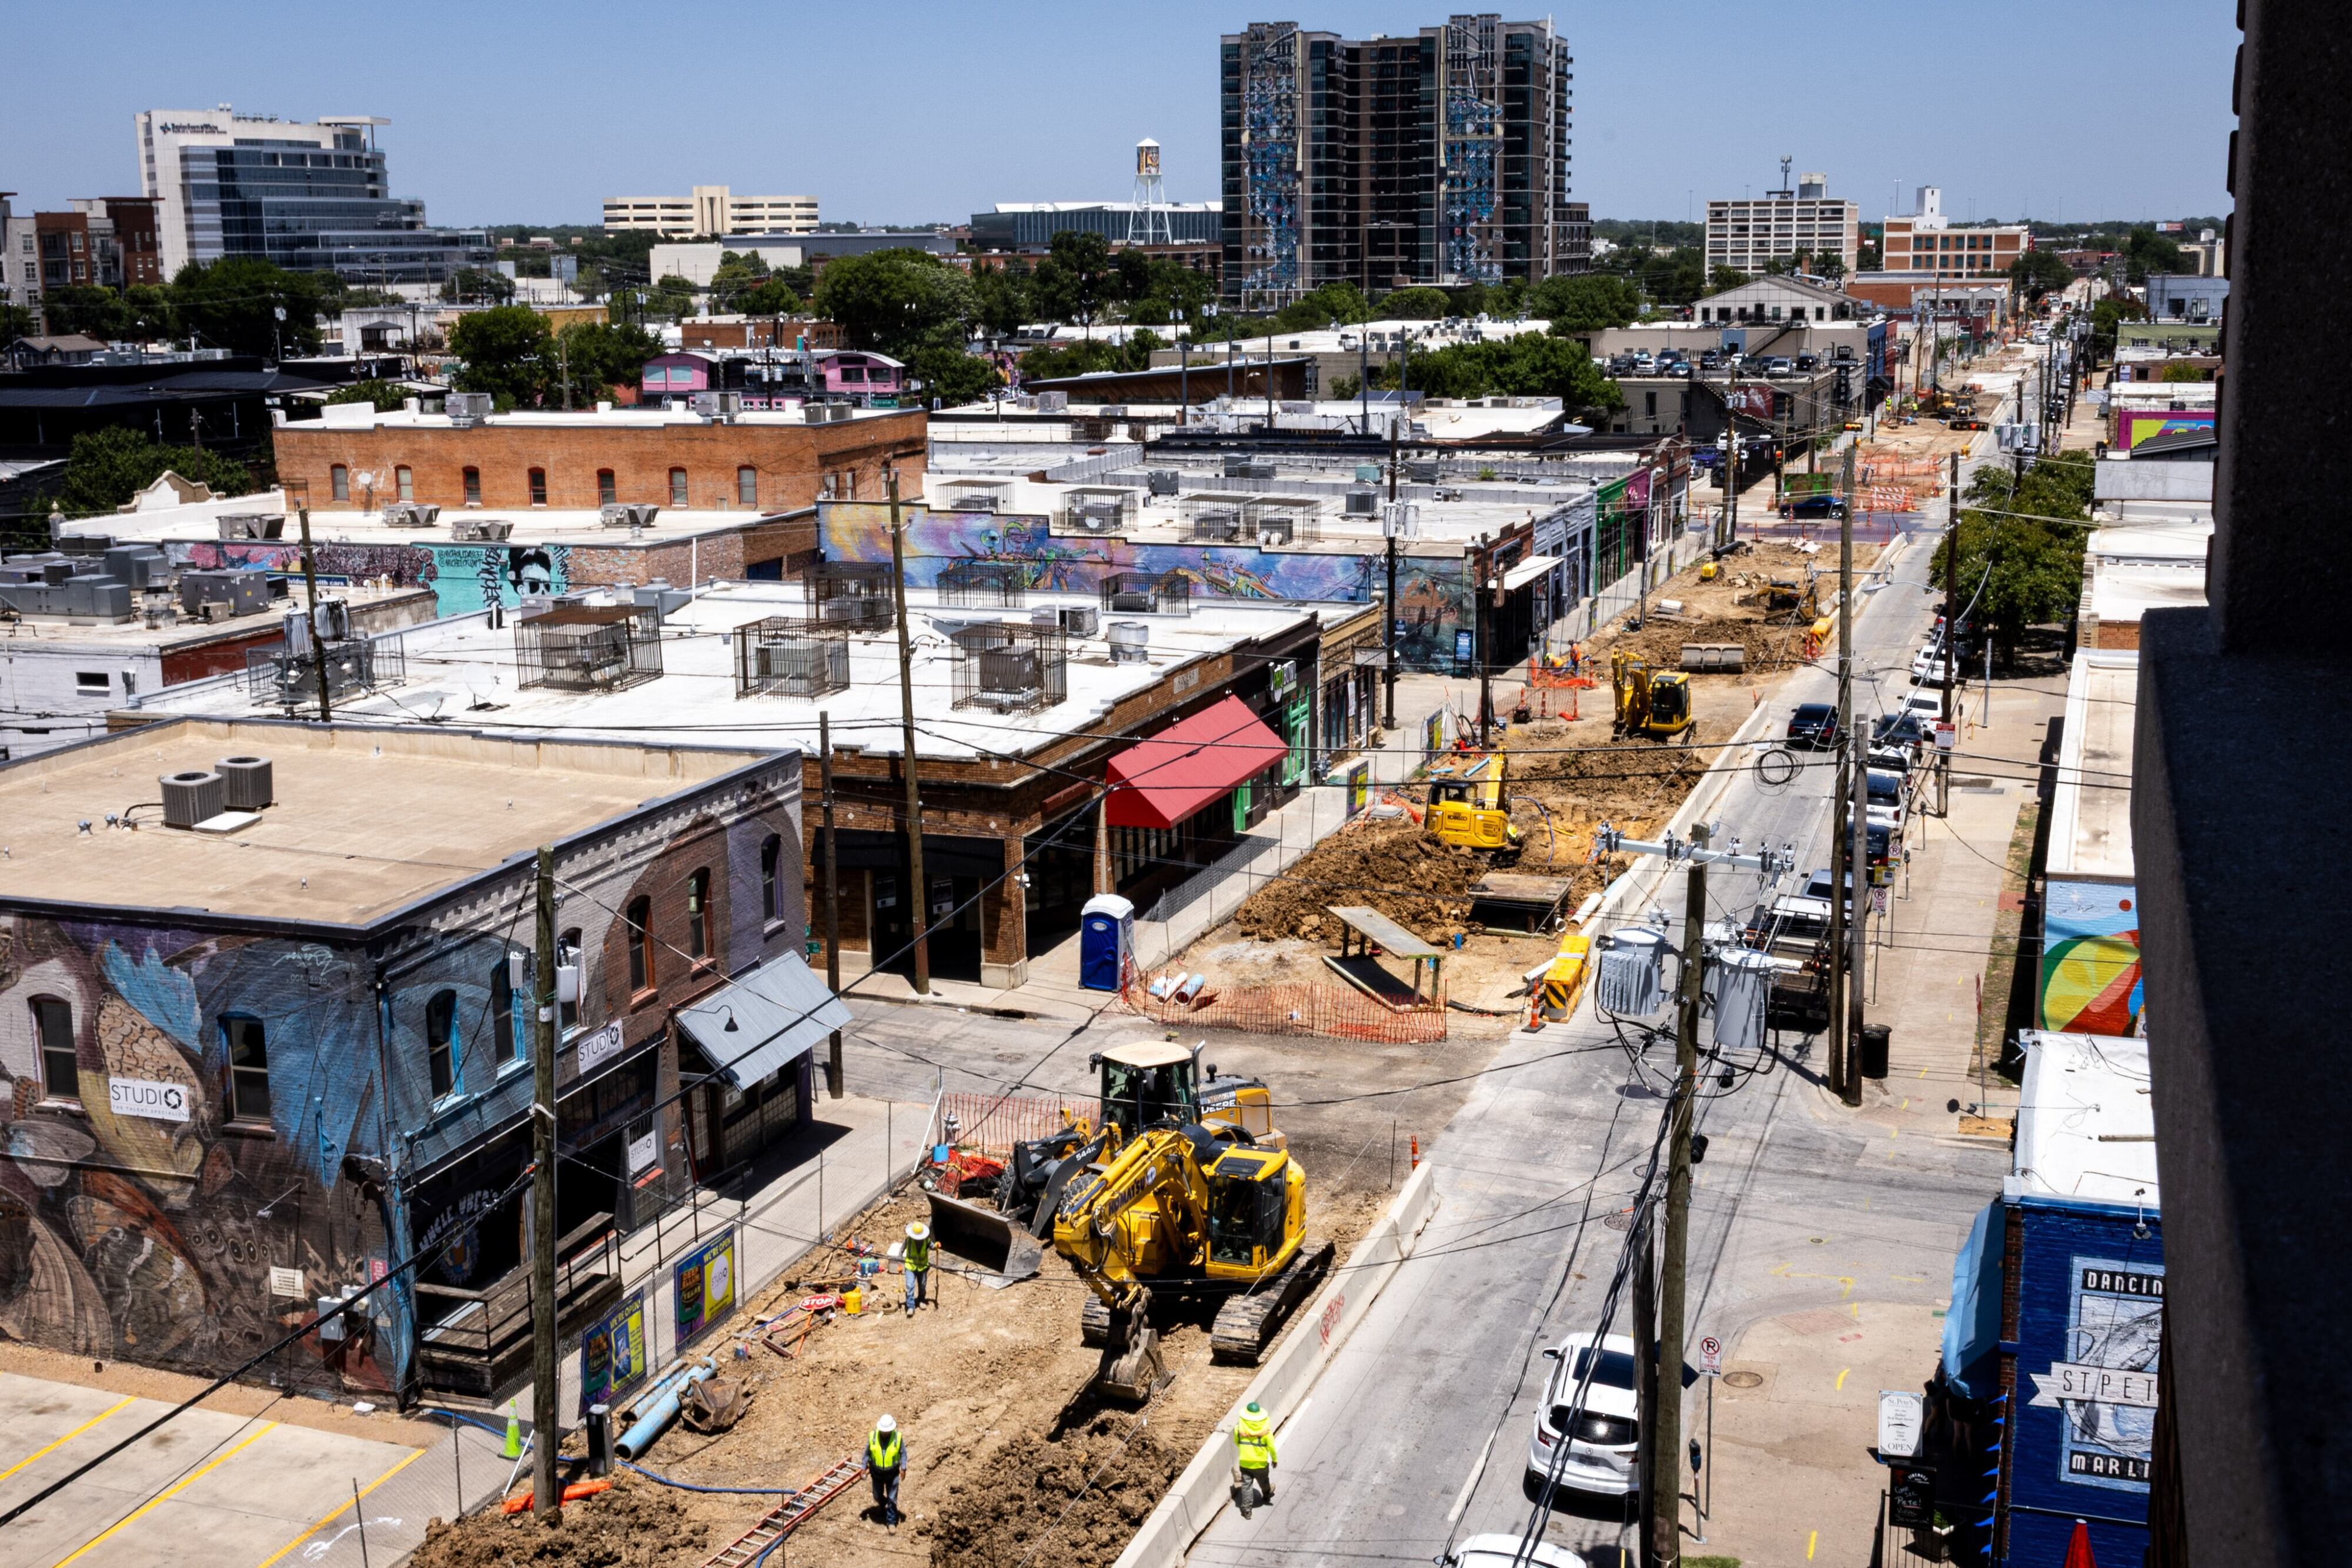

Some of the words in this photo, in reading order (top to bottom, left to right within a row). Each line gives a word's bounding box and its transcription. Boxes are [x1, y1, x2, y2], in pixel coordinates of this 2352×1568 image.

[316, 577, 328, 586] with
[579, 1027, 619, 1062] STUDIO
[111, 1084, 182, 1110] STUDIO
[1201, 1099, 1237, 1114] DEERE
[630, 1138, 652, 1159] STUDIO
[1075, 1145, 1097, 1161] 544K
[1108, 1176, 1146, 1216] KOMATSU
[419, 1205, 455, 1254] UNCLE
[703, 1246, 720, 1263] WE'RE
[683, 1266, 700, 1281] DEEP
[711, 1268, 727, 1286] STUDIO
[683, 1285, 701, 1300] TEXAS
[802, 1298, 833, 1306] STOP
[610, 1311, 625, 1329] WE'RE
[624, 1298, 642, 1316] OPEN!
[590, 1353, 609, 1370] TEXAS
[1887, 1442, 1913, 1452] OPEN
